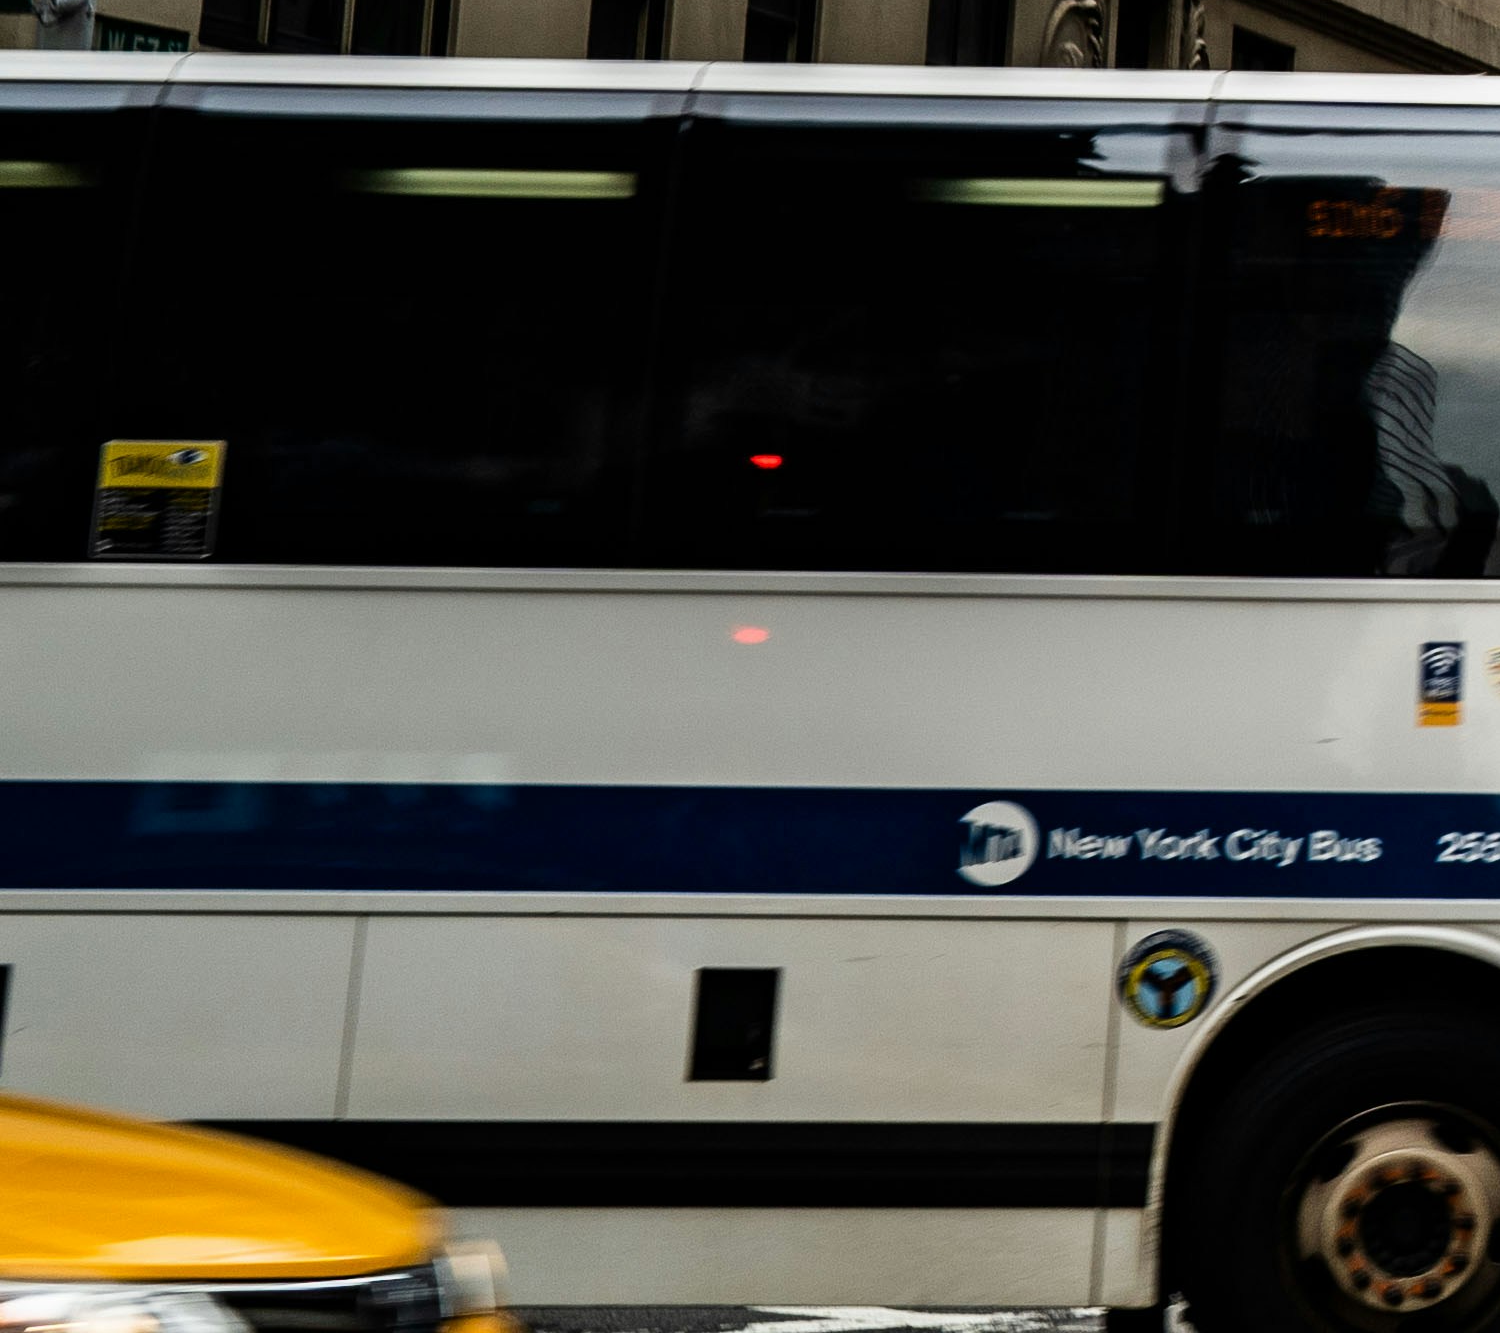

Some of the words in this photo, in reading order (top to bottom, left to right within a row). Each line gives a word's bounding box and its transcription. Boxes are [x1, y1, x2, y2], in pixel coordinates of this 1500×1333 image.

[1046, 827, 1134, 860] New
[1134, 826, 1223, 861] York
[1225, 827, 1305, 868] City
[1307, 829, 1384, 863] Bus
